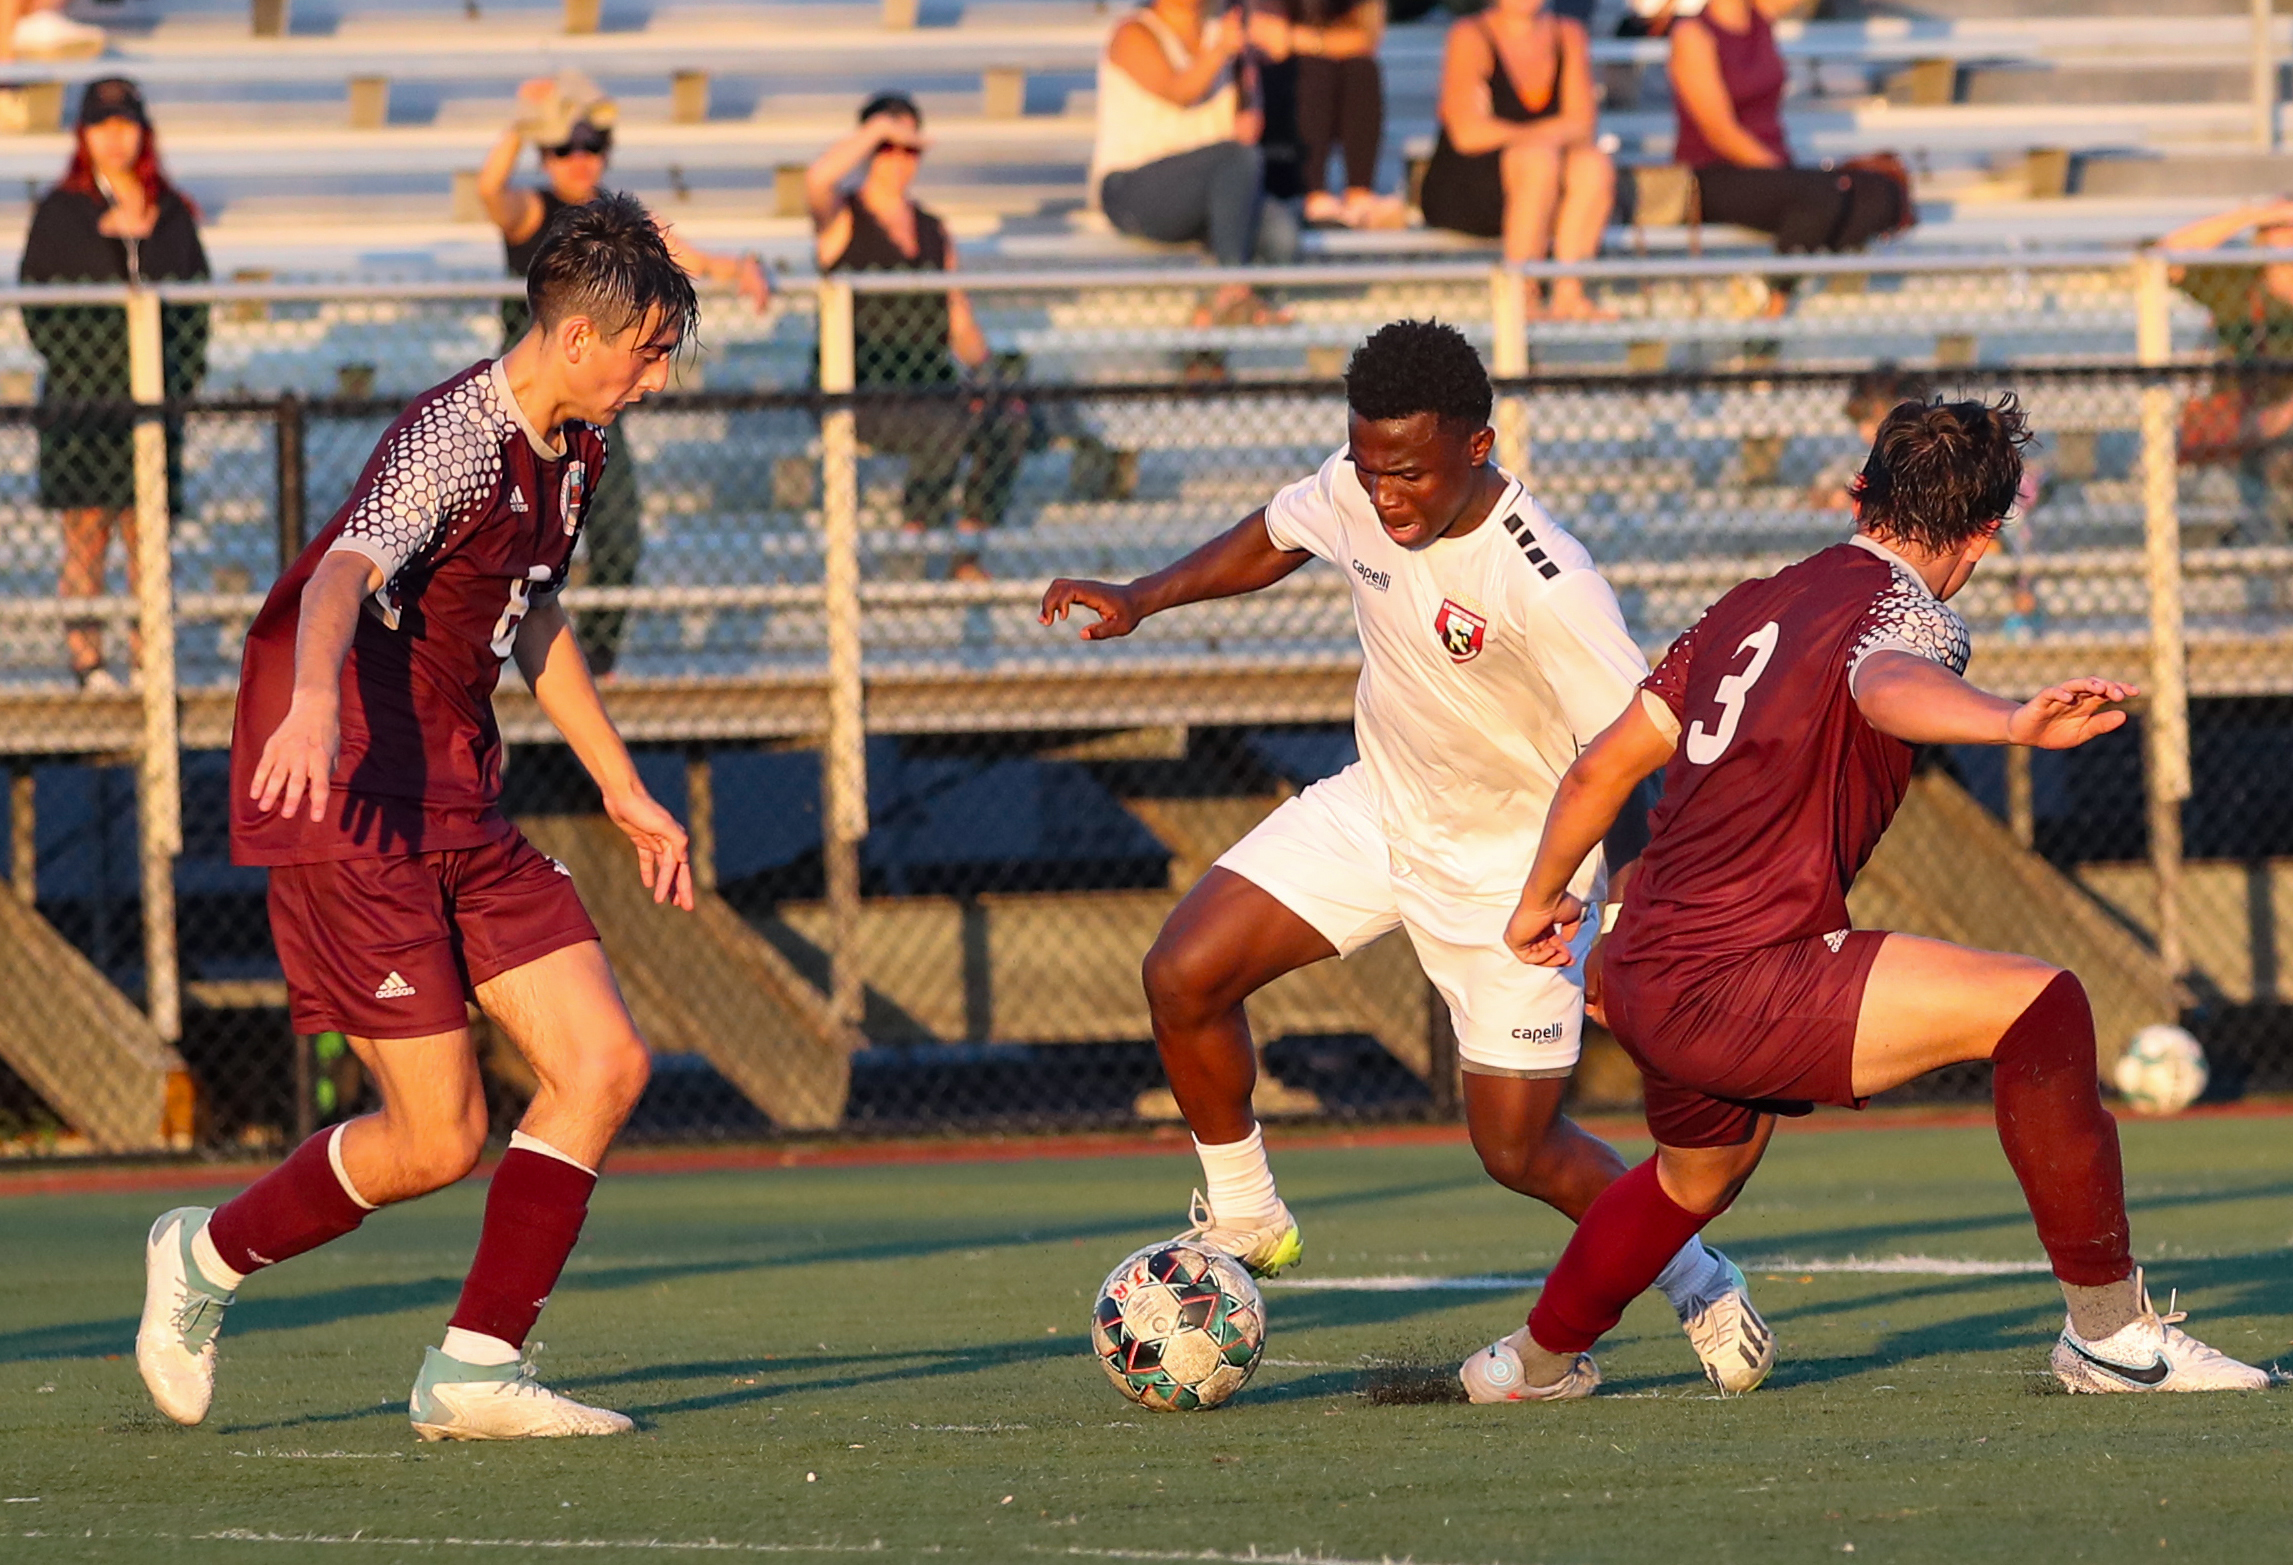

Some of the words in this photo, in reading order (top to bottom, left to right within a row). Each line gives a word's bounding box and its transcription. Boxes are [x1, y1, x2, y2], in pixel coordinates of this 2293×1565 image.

[1352, 558, 1391, 589] capelli
[1686, 620, 1780, 765] 3
[375, 986, 416, 999] adidas
[1511, 1022, 1562, 1043] capelli
